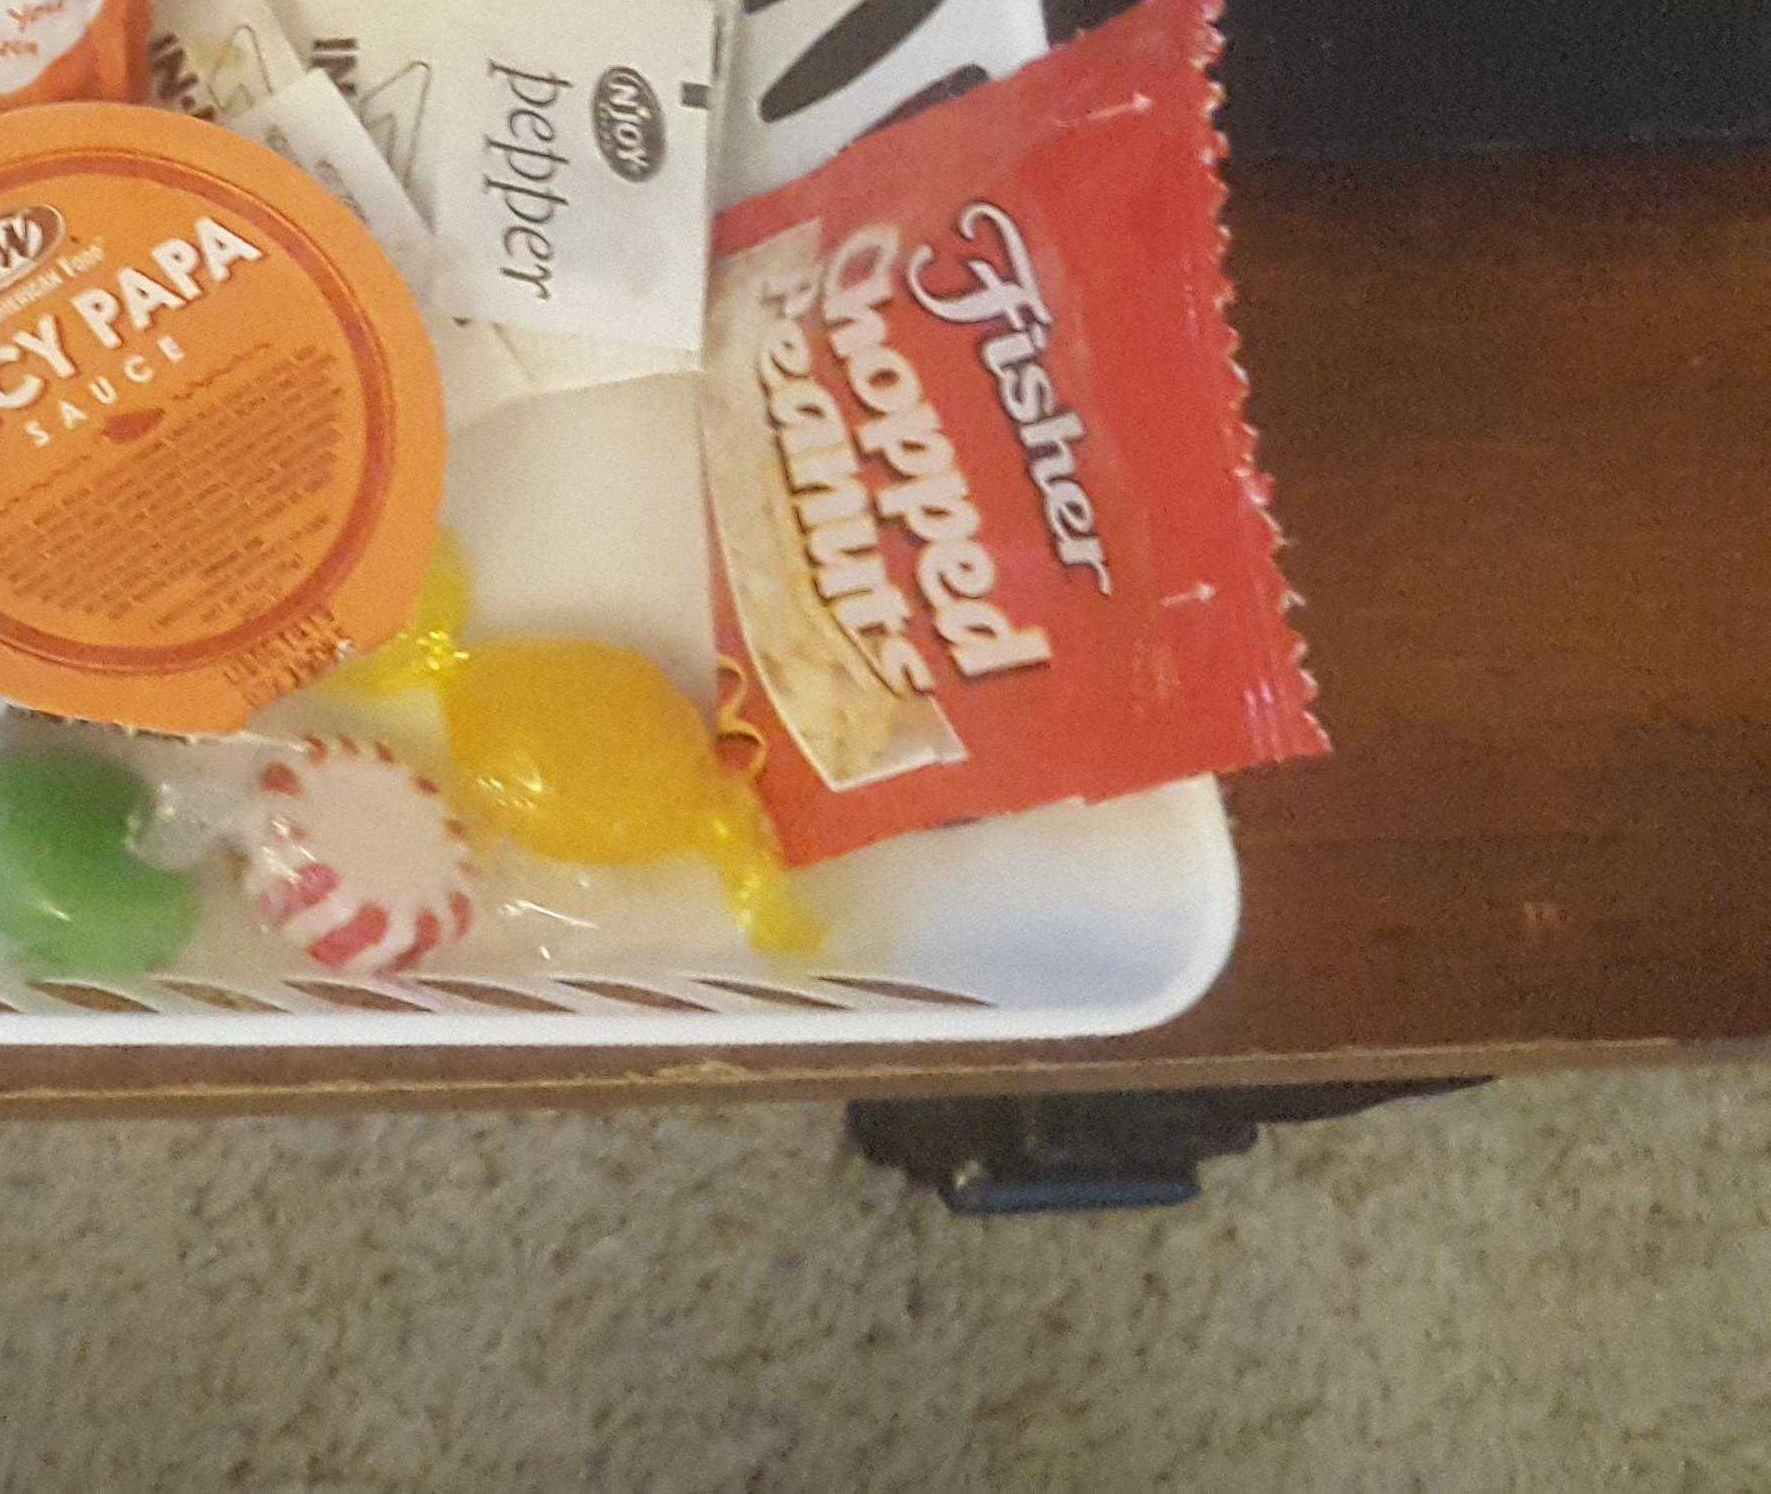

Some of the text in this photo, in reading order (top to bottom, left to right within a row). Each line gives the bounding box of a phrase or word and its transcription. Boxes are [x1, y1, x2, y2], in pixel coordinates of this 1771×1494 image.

[70, 215, 265, 350] PAPA
[483, 58, 575, 302] pepper
[23, 334, 186, 448] SAUCE
[755, 274, 939, 701] Peanuts
[820, 221, 1052, 678] Chopped
[905, 200, 1113, 597] Fisher
